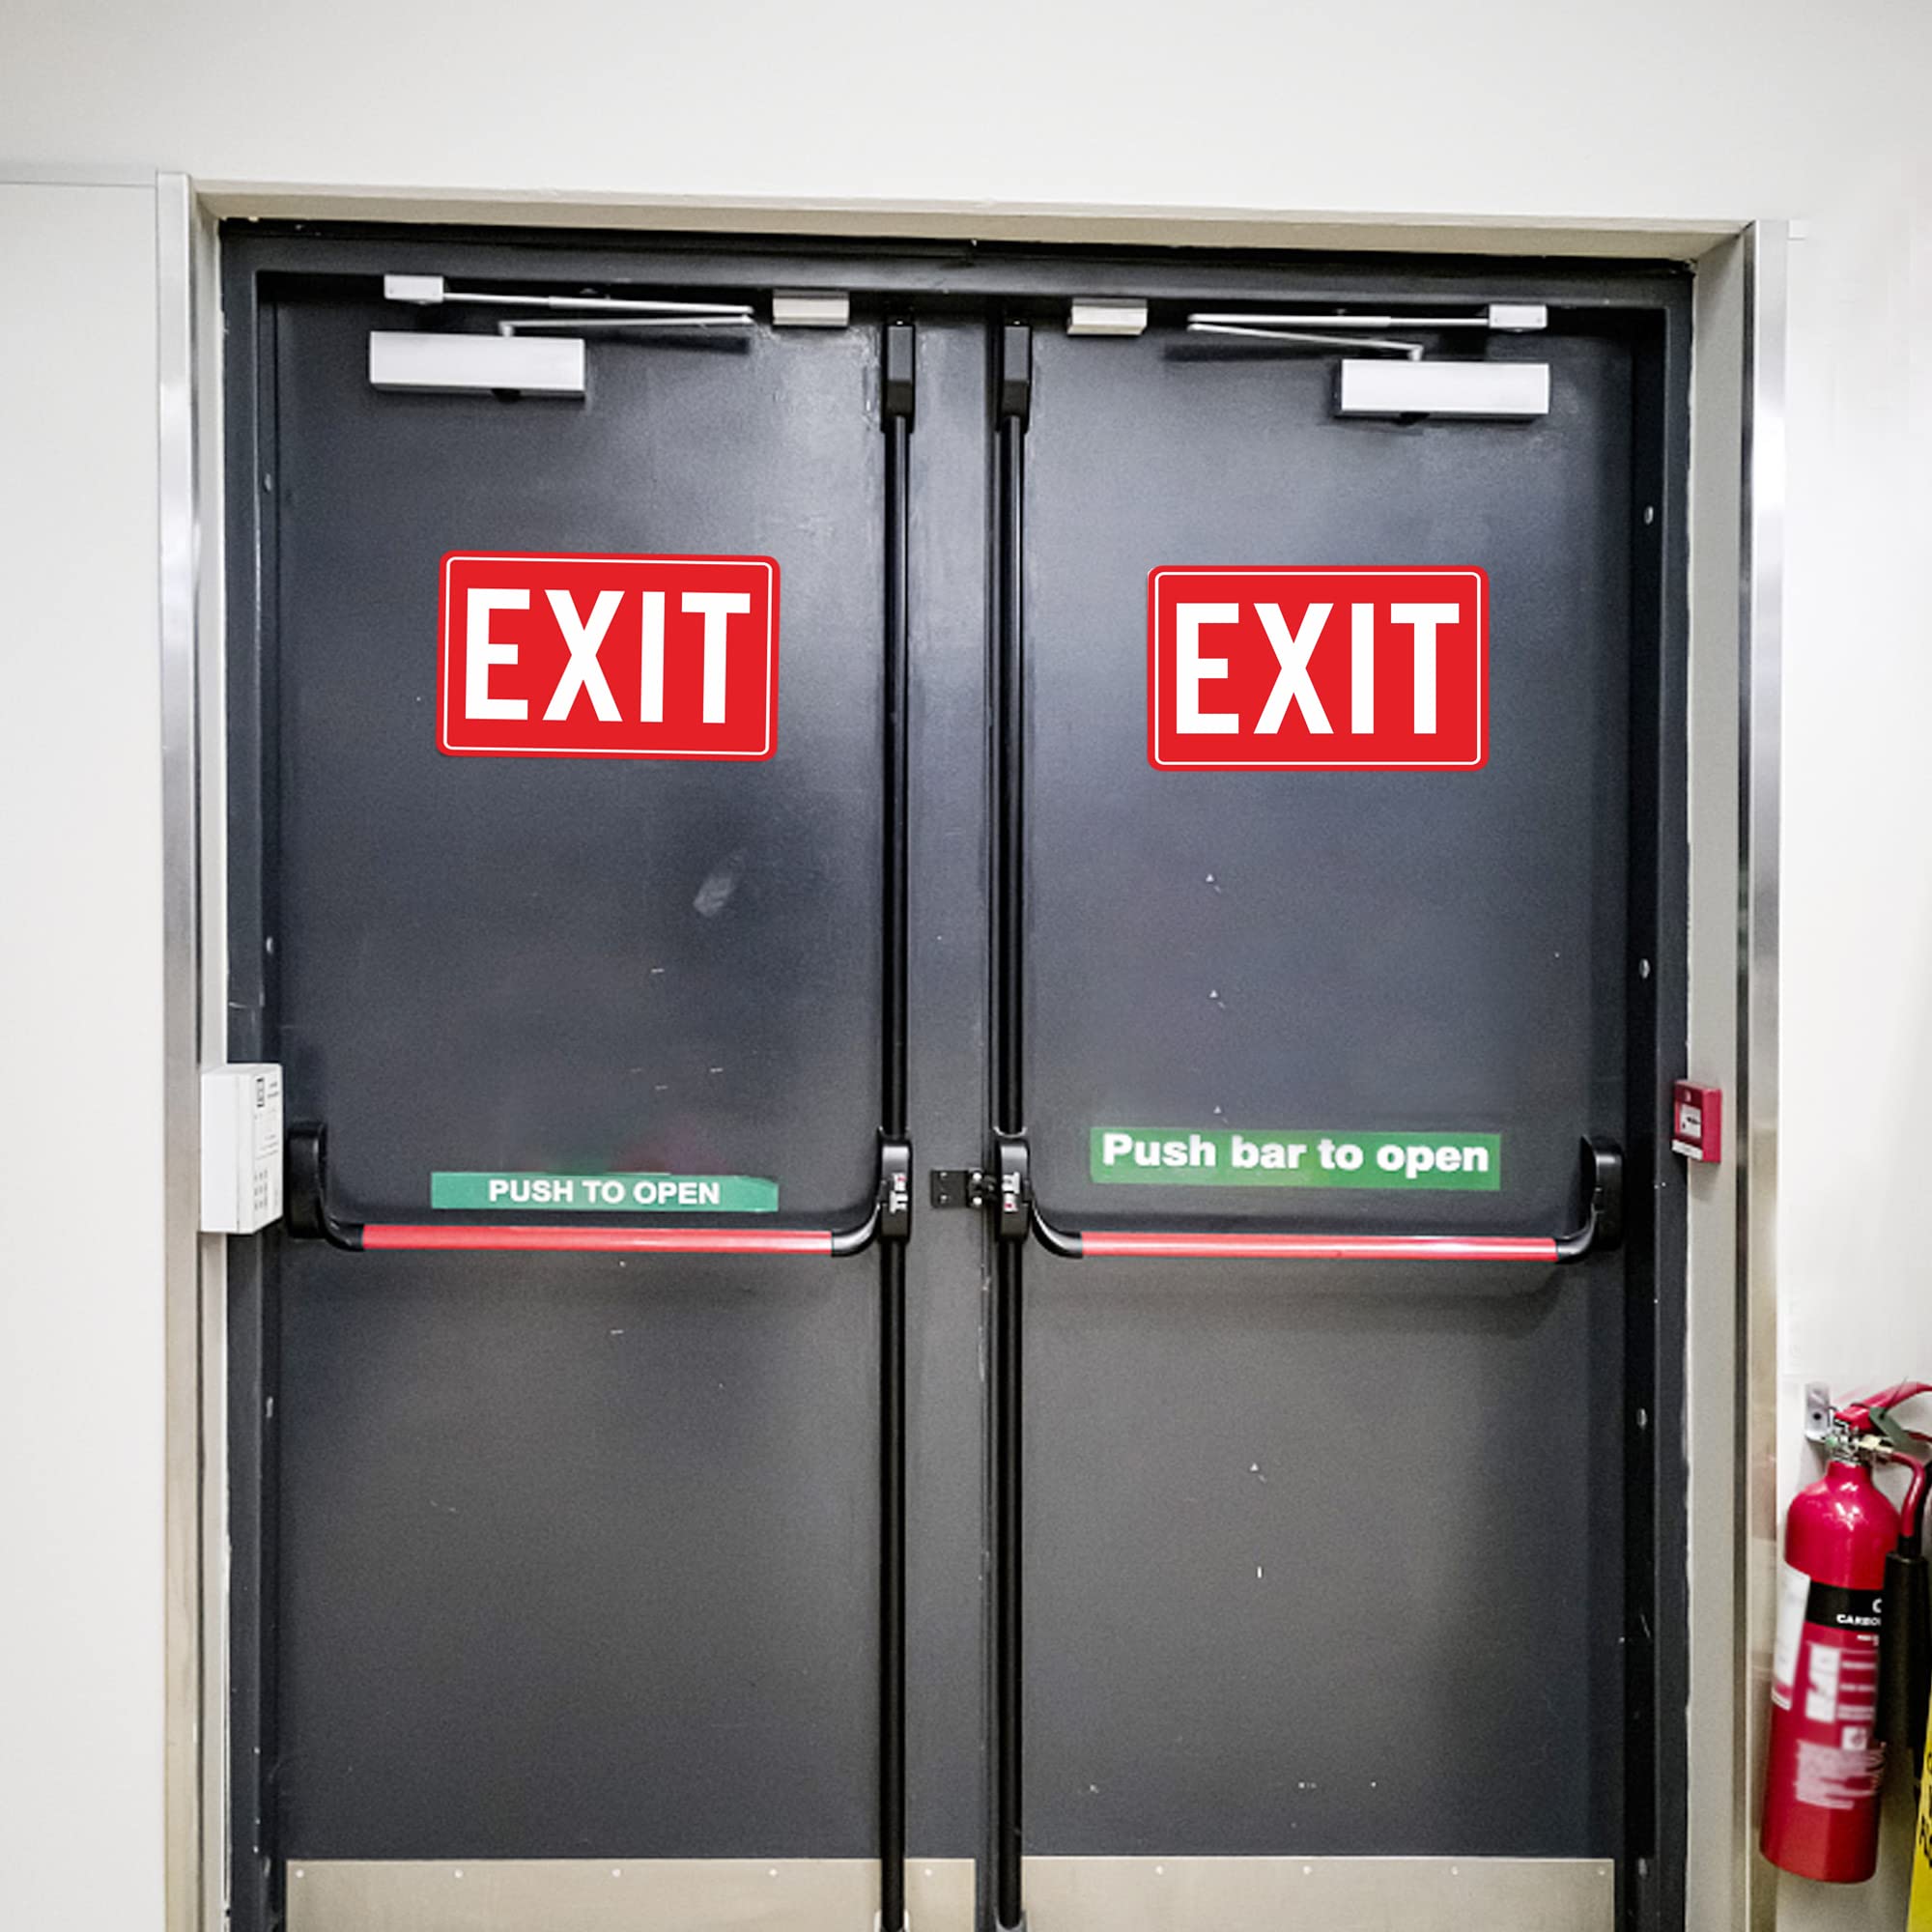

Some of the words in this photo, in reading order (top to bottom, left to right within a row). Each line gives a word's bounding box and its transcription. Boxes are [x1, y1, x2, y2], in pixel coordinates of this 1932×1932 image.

[465, 587, 751, 724] EXIT
[1176, 603, 1460, 734] EXIT
[488, 1179, 574, 1204] PUSH
[582, 1180, 627, 1205] TO
[633, 1180, 722, 1206] OPEN
[1102, 1132, 1216, 1168] Push
[1231, 1135, 1307, 1170] bar
[1317, 1138, 1364, 1171] to
[1376, 1144, 1490, 1179] open
